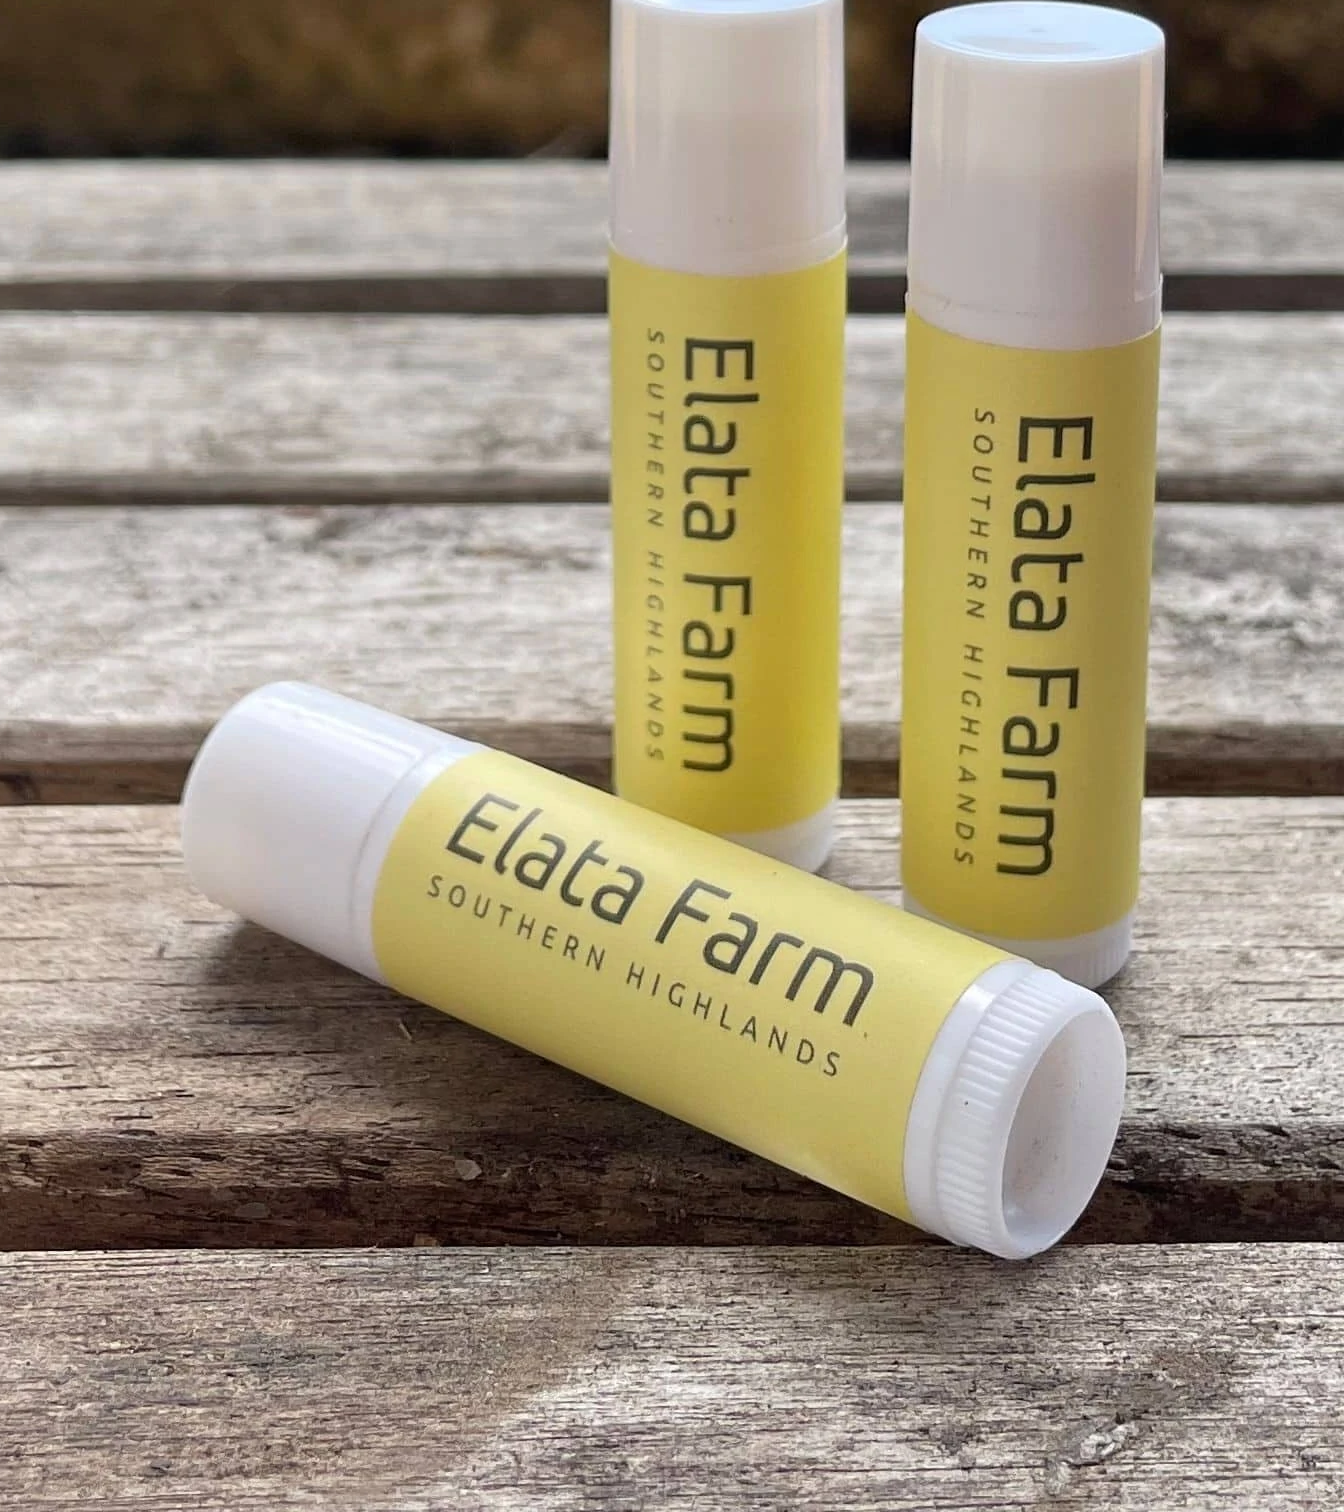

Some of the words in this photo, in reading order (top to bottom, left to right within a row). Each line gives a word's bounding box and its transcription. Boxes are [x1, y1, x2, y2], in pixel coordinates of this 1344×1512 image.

[645, 327, 666, 528] SOUTHERN
[682, 336, 760, 542] Elata
[965, 407, 996, 619] SOUTHERN
[1008, 415, 1096, 632] Elata
[644, 550, 665, 762] HIGHLANDS
[681, 572, 753, 774] Farm
[953, 643, 984, 866] HIGHLANDS
[995, 665, 1080, 877] Farm
[425, 873, 608, 973] SOUTHERN
[625, 965, 842, 1079] HIGHLANDS
[444, 791, 647, 925] Elata
[655, 878, 876, 1028] Farm
